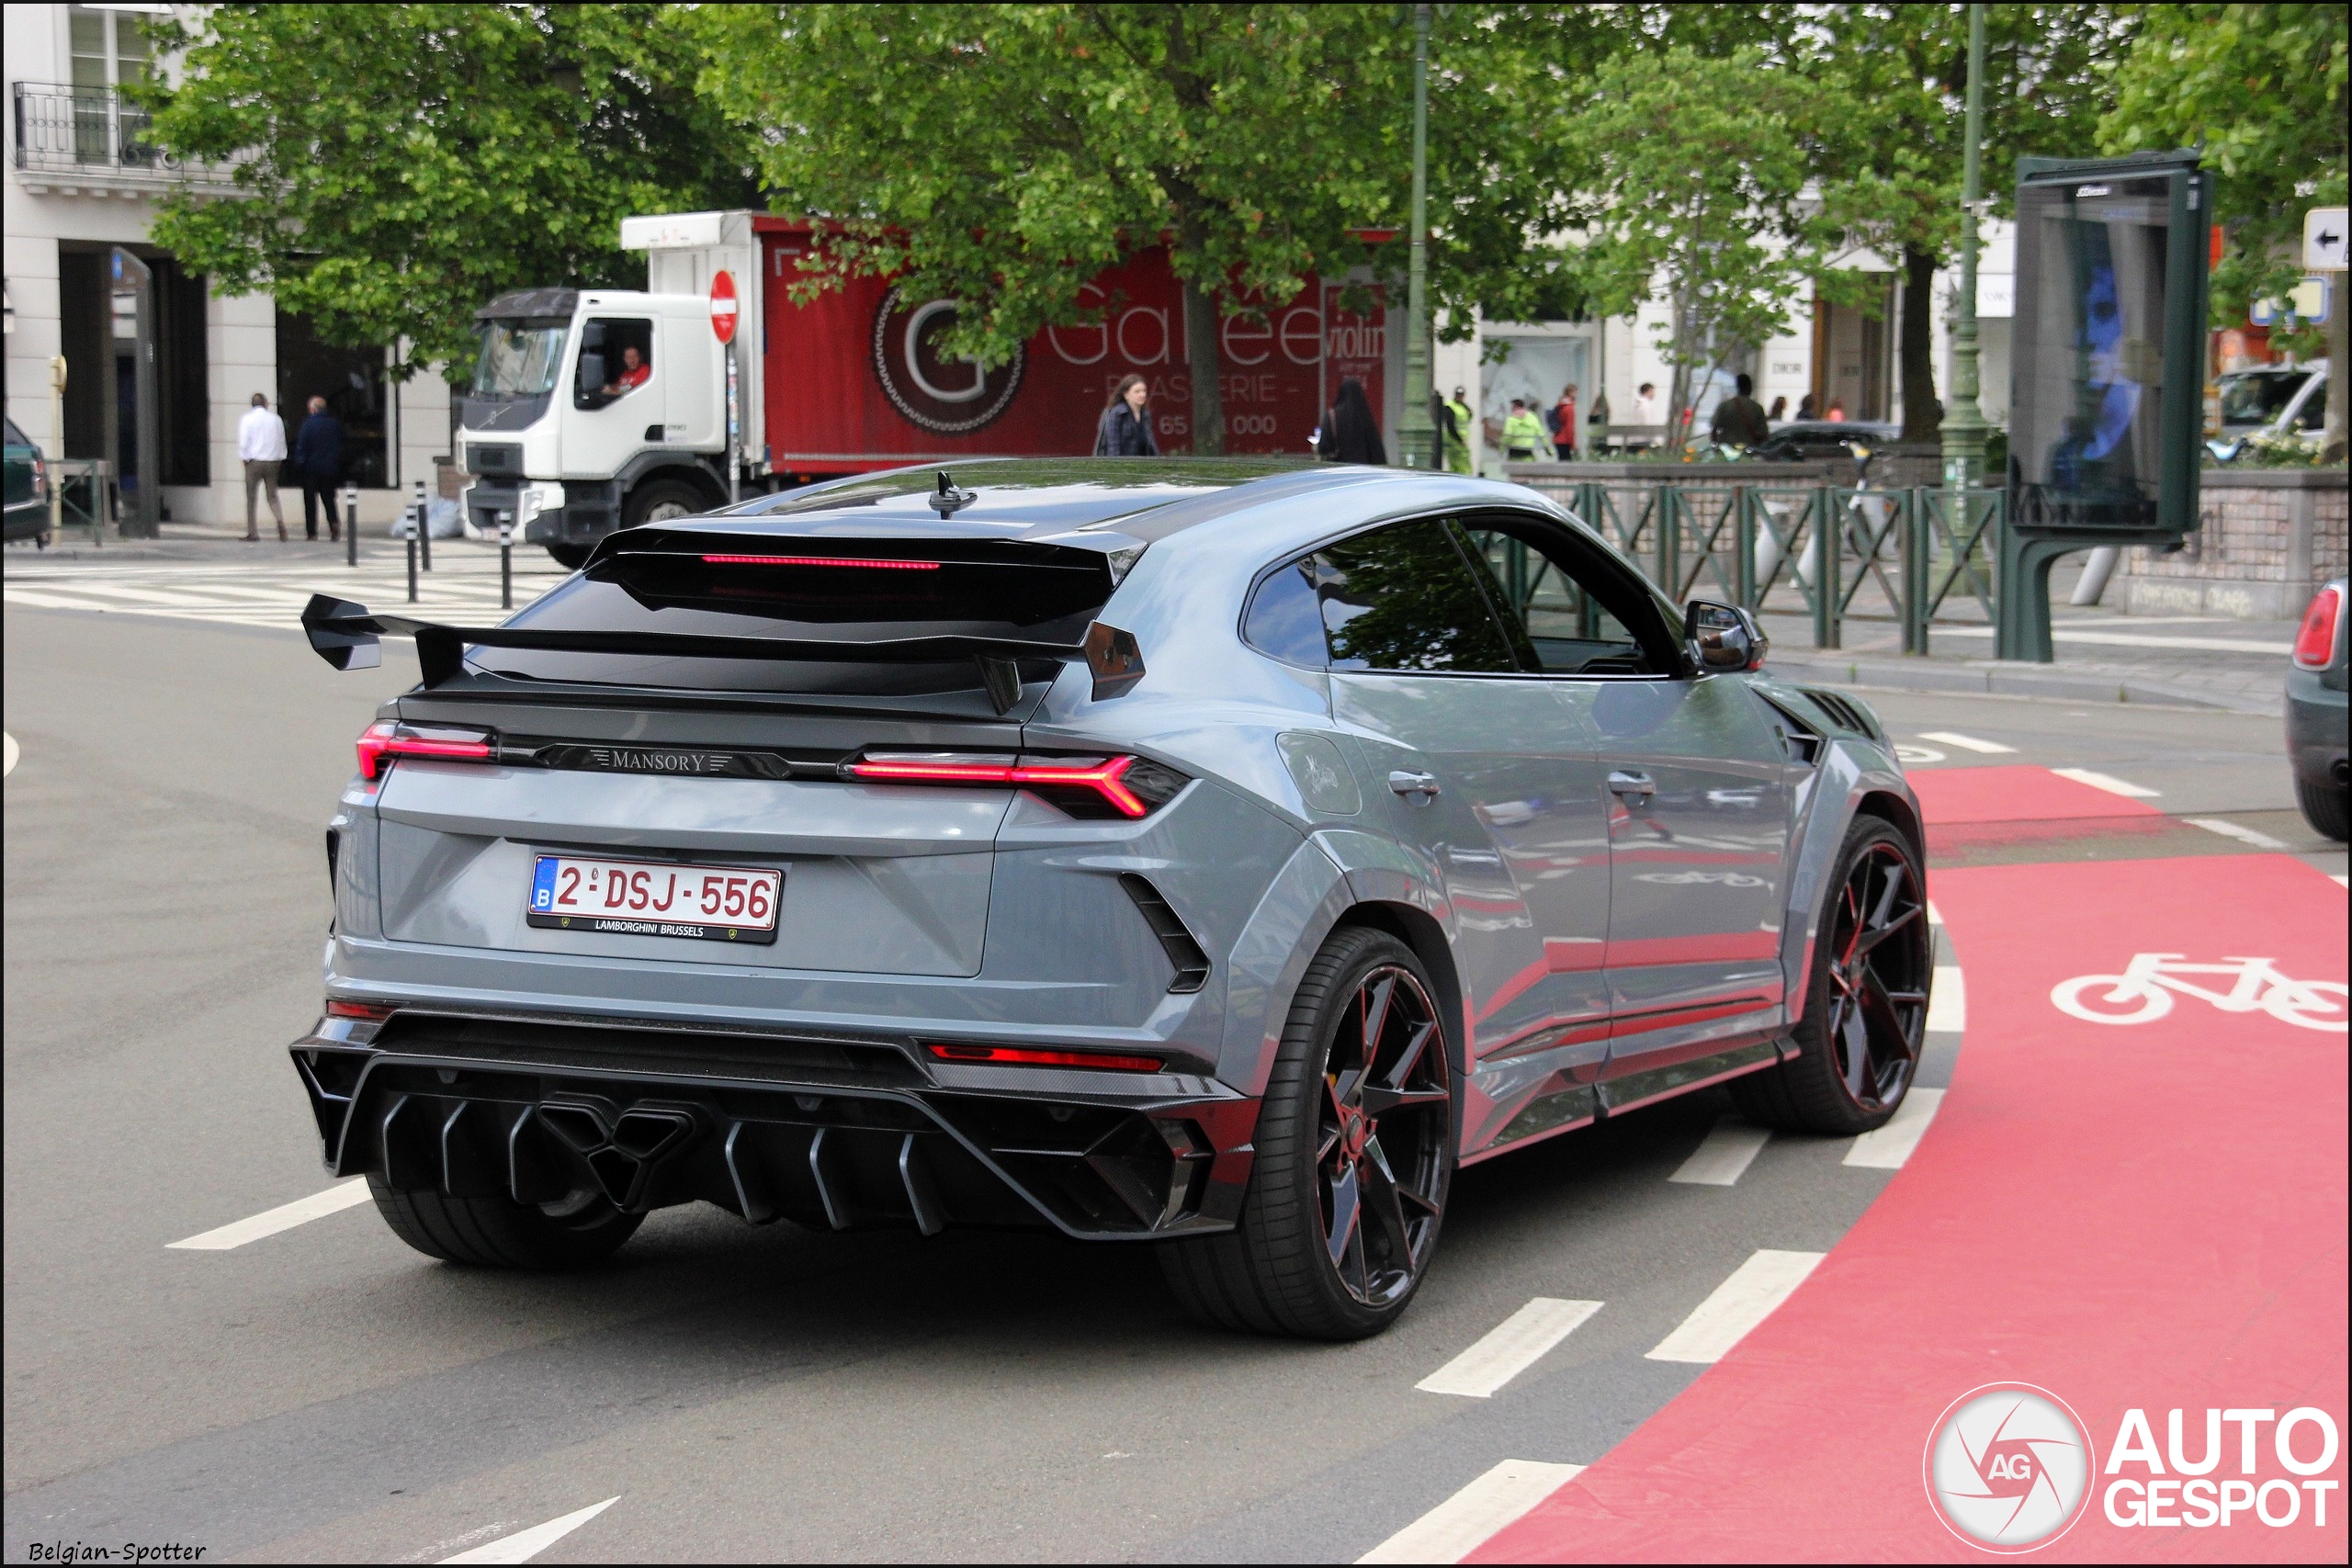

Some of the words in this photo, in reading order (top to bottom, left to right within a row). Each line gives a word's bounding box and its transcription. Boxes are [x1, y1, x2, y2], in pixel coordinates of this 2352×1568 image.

[613, 750, 706, 772] MANSORY
[537, 889, 550, 907] B
[595, 919, 658, 934] LAMBORGHINI
[661, 924, 705, 938] BRUSSELS
